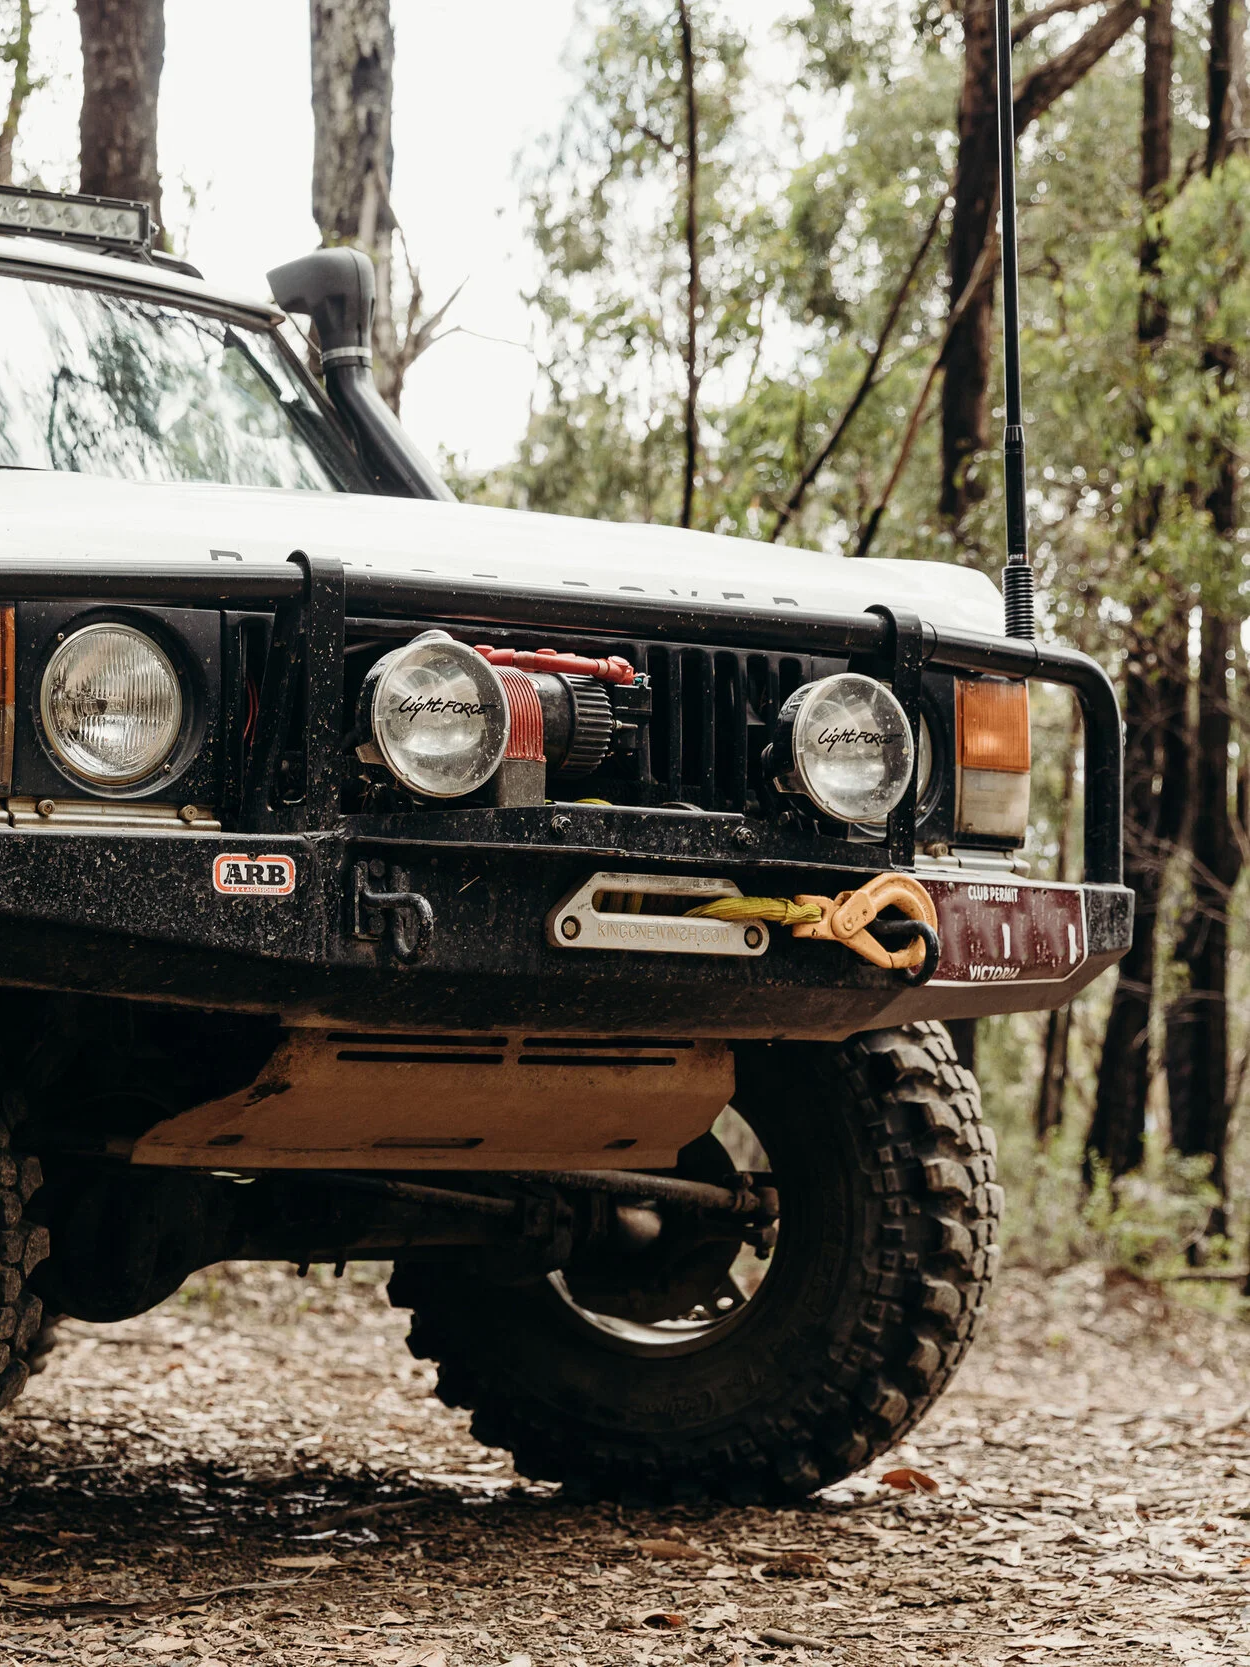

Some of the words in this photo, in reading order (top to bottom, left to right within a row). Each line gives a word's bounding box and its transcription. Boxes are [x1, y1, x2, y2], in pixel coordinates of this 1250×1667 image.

[223, 863, 286, 885] ARB
[967, 885, 989, 901] CLUB
[990, 886, 1018, 902] PERMIT
[597, 922, 730, 943] KINGONEWINCH.COM
[969, 964, 1020, 980] VICTORIA
